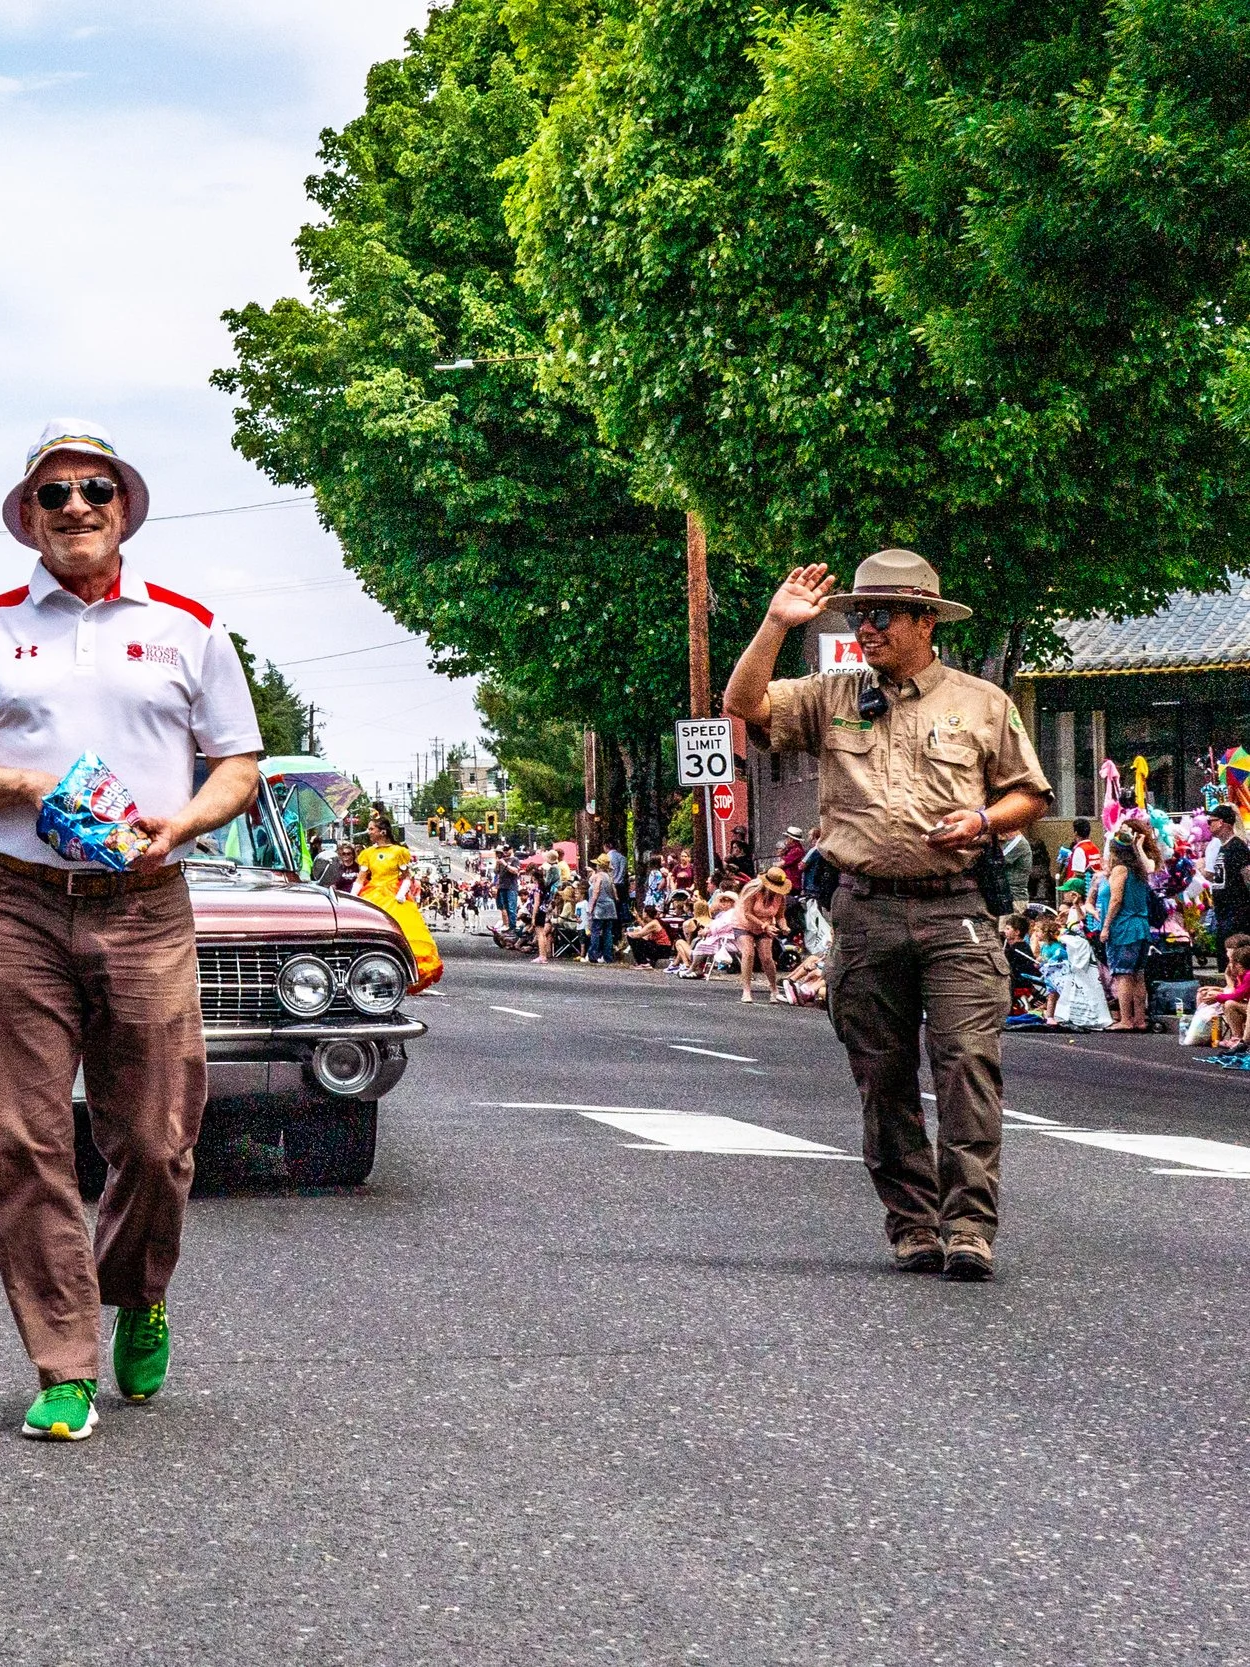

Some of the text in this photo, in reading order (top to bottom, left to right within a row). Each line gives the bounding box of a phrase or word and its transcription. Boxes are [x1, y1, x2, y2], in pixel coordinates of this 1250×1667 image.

[146, 647, 178, 661] ROSE
[681, 725, 726, 737] SPEED
[687, 739, 722, 751] LIMIT
[685, 752, 728, 778] 30
[92, 780, 125, 814] DUBB
[713, 795, 733, 809] STOP
[105, 790, 133, 820] BUBB
